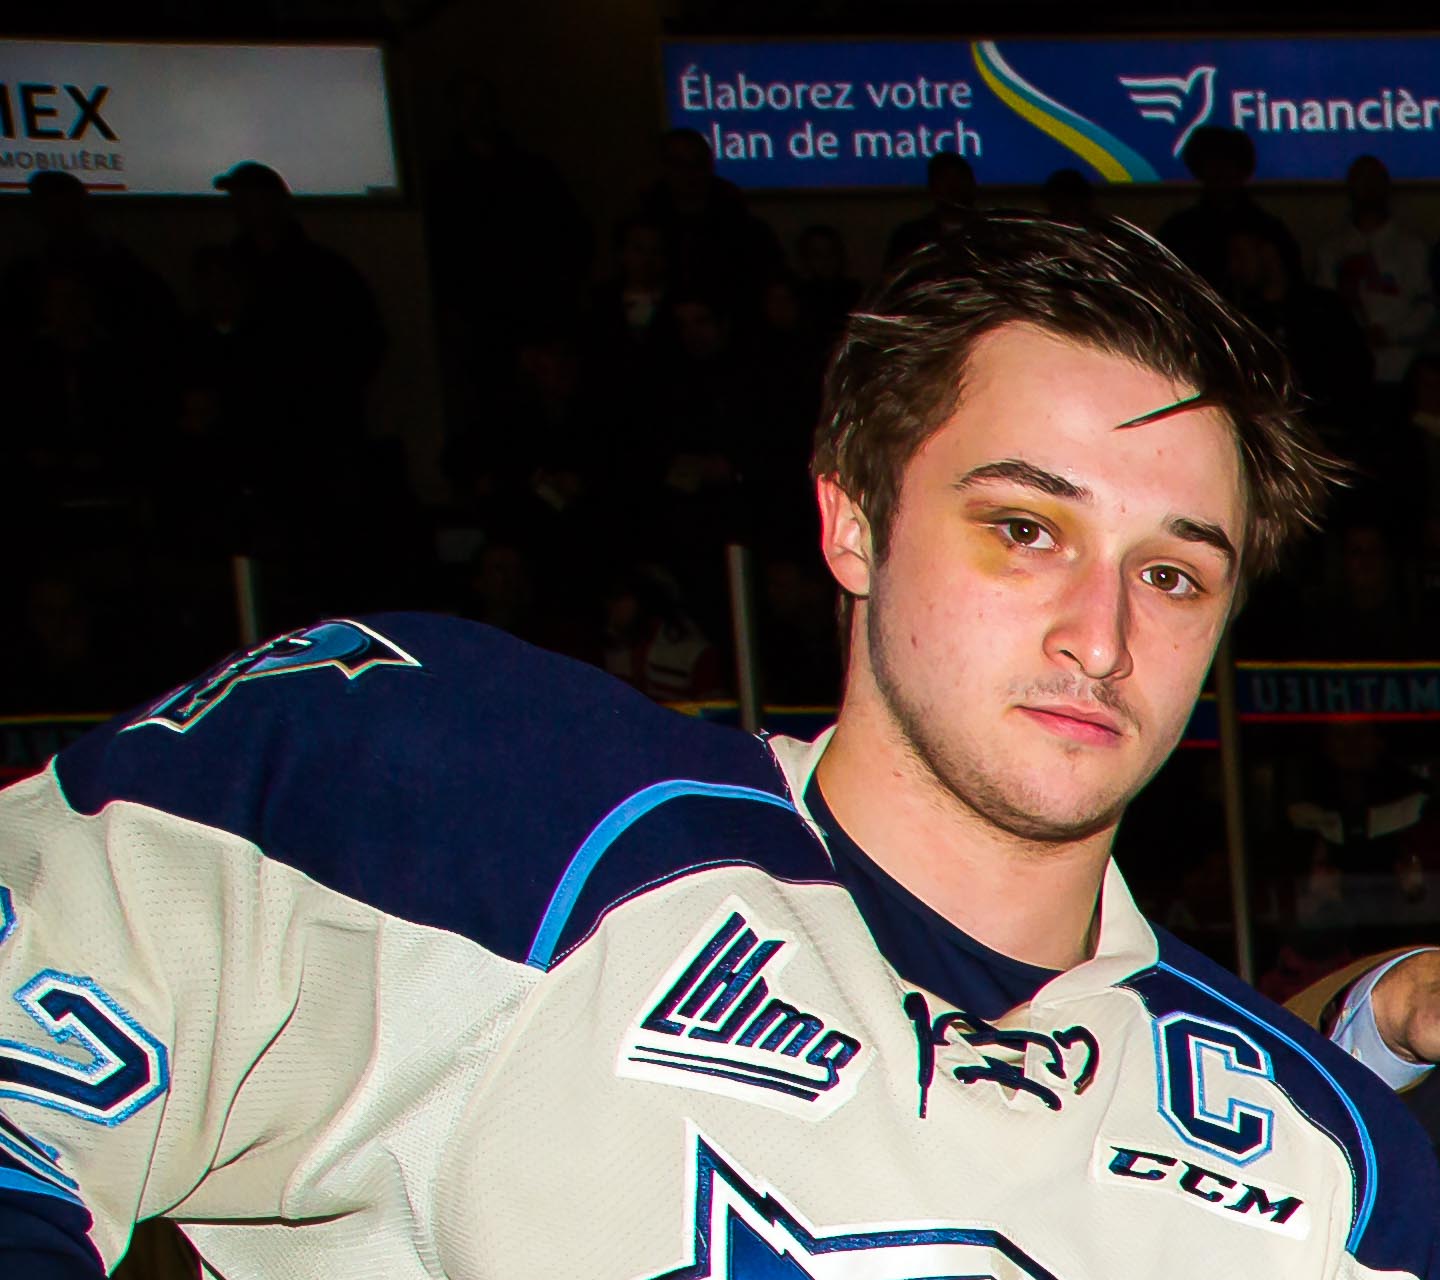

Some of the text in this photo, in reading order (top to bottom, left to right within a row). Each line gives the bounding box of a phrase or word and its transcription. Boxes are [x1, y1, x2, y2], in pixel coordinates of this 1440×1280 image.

[680, 64, 973, 112] Élaborez votre
[705, 119, 982, 160] lan de match
[1152, 1011, 1275, 1166] C
[1107, 1146, 1304, 1225] CCM
